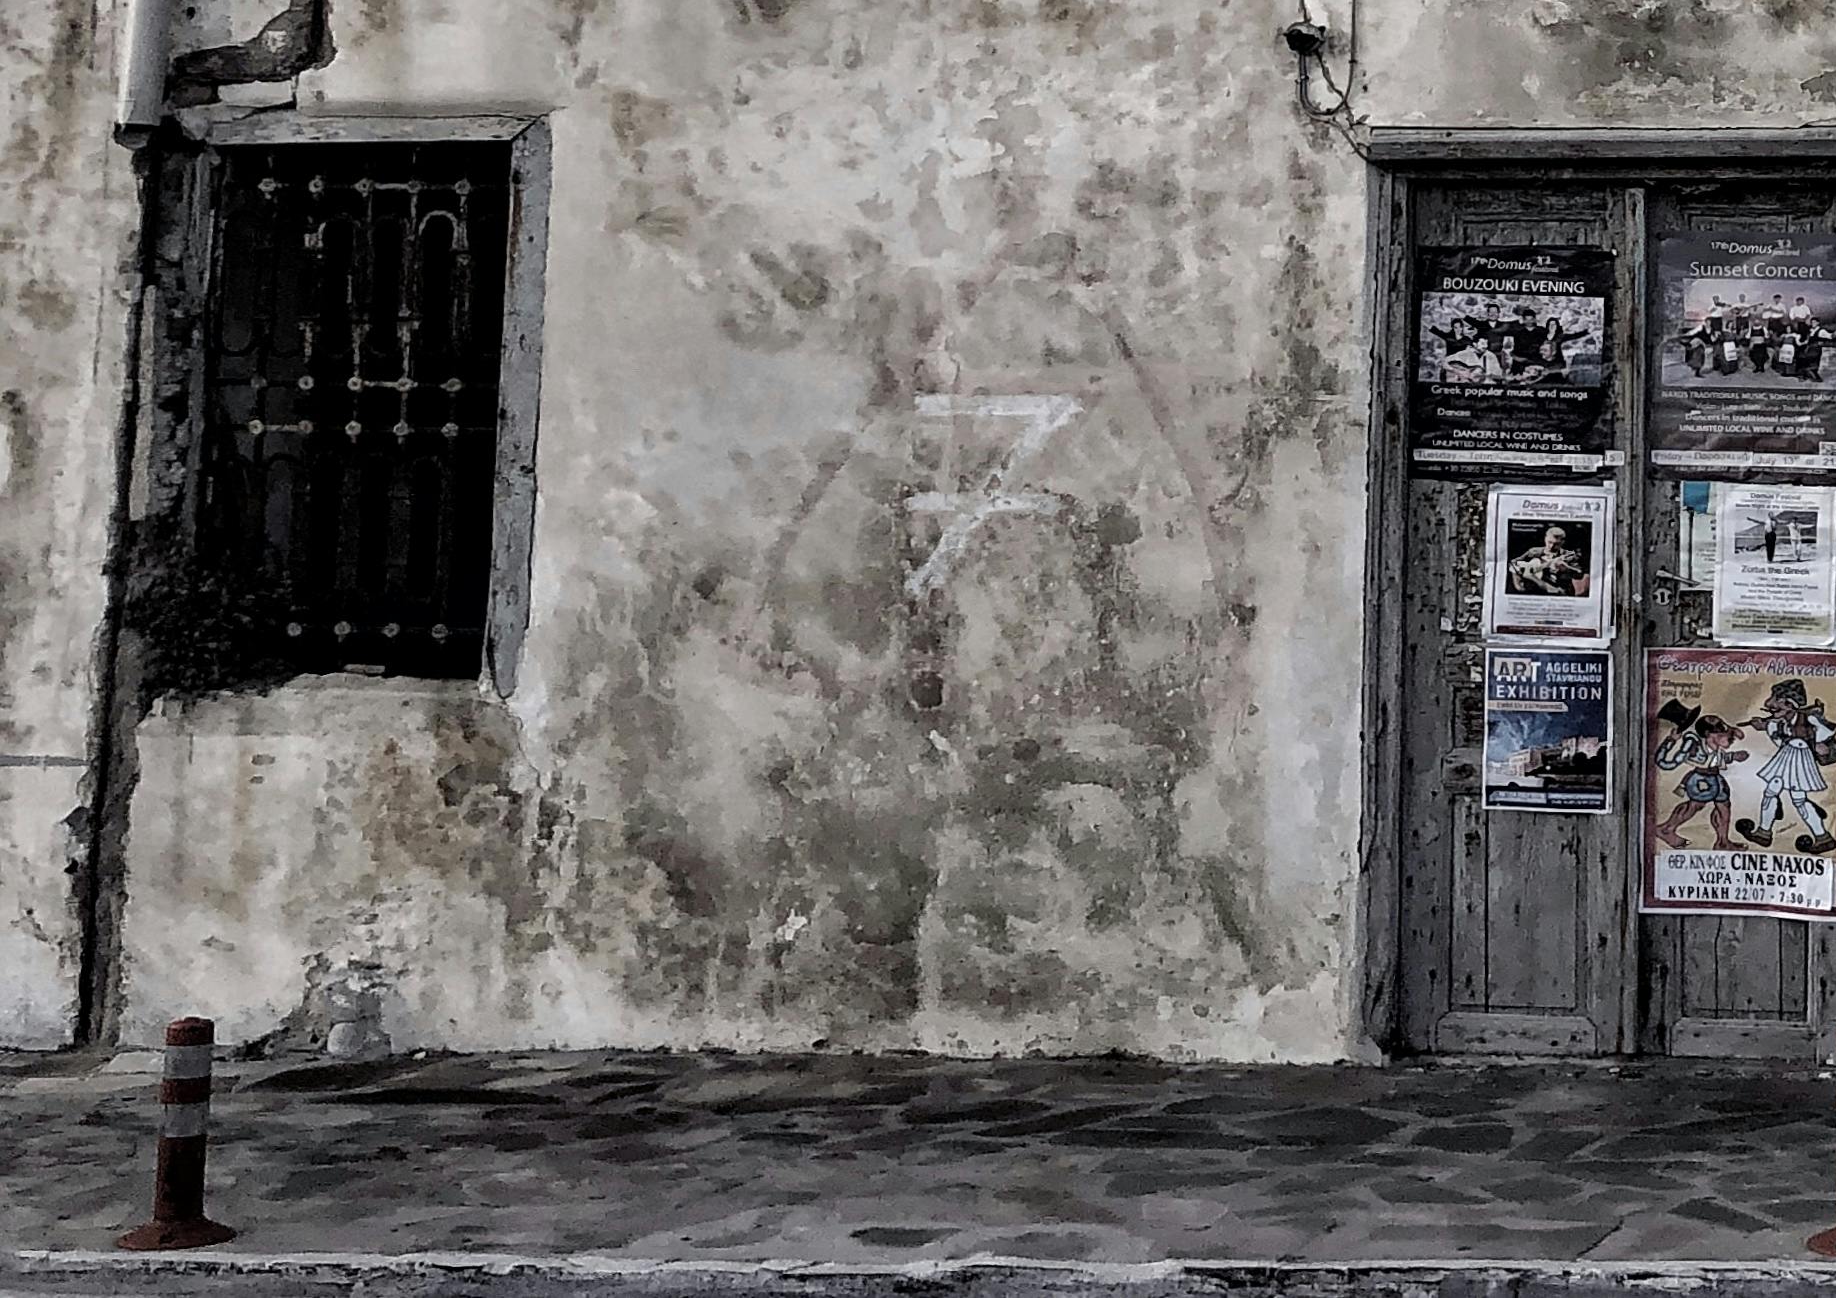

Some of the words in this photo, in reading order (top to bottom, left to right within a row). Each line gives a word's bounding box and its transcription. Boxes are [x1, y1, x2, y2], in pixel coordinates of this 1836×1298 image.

[1728, 242, 1773, 254] Domus
[1487, 257, 1532, 270] Domus
[1689, 261, 1750, 277] Sunset
[1753, 262, 1823, 279] Concert
[1443, 276, 1519, 292] BOUZOUKI
[1522, 279, 1585, 294] EVENING
[1431, 385, 1462, 395] Greek
[1464, 388, 1503, 398] popular
[1506, 388, 1534, 397] music
[1537, 389, 1556, 398] and
[1560, 391, 1588, 401] songs
[1732, 414, 1779, 423] traditional
[1453, 429, 1497, 439] DANCERS
[1500, 431, 1511, 440] IN
[1513, 432, 1564, 441] COSTUMES
[1725, 425, 1751, 433] LOCAL
[1776, 426, 1794, 434] AND
[1476, 440, 1504, 449] LOCAL
[1495, 661, 1541, 682] ART
[1545, 662, 1602, 673] AGGELIKI
[1545, 674, 1602, 683] STAVRIANOU
[1496, 684, 1602, 700] EXHIBITION
[1730, 853, 1768, 871] CINE
[1772, 855, 1825, 876] NAXOS
[1697, 871, 1732, 885] ΧΩΡΑ
[1744, 873, 1797, 888] ΝΑΞΟΣ
[1668, 885, 1730, 900] ΚΥΡΙΑΚΗ
